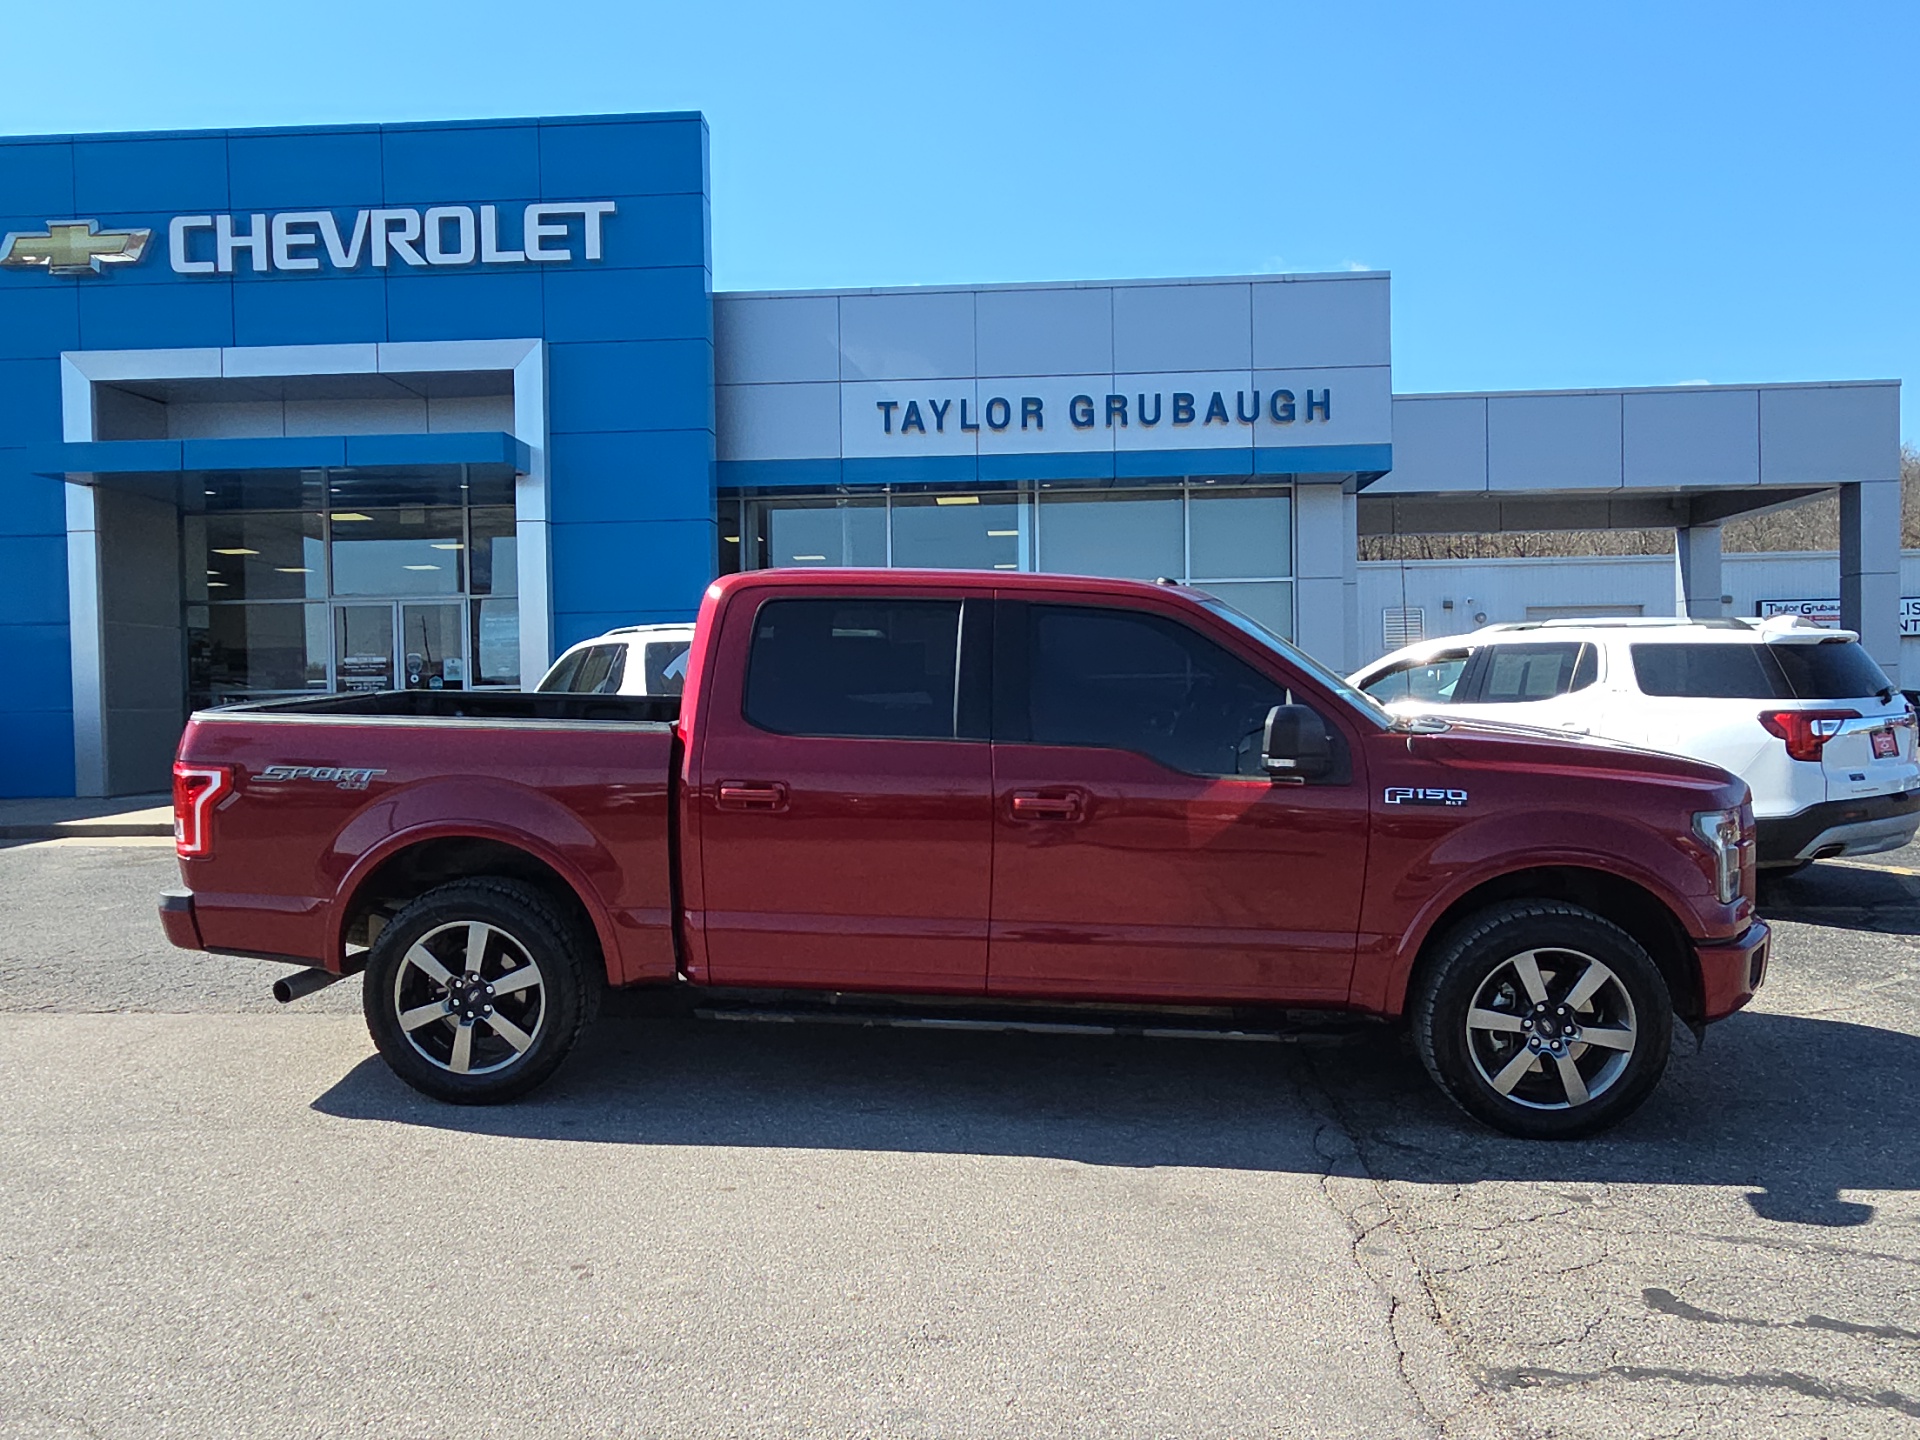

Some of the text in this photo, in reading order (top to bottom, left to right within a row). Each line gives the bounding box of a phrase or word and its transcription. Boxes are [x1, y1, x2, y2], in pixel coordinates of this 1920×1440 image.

[169, 200, 616, 273] CHEVROLET
[876, 388, 1331, 434] TAYLOR GRUBAUGH
[250, 765, 388, 782] SPORT
